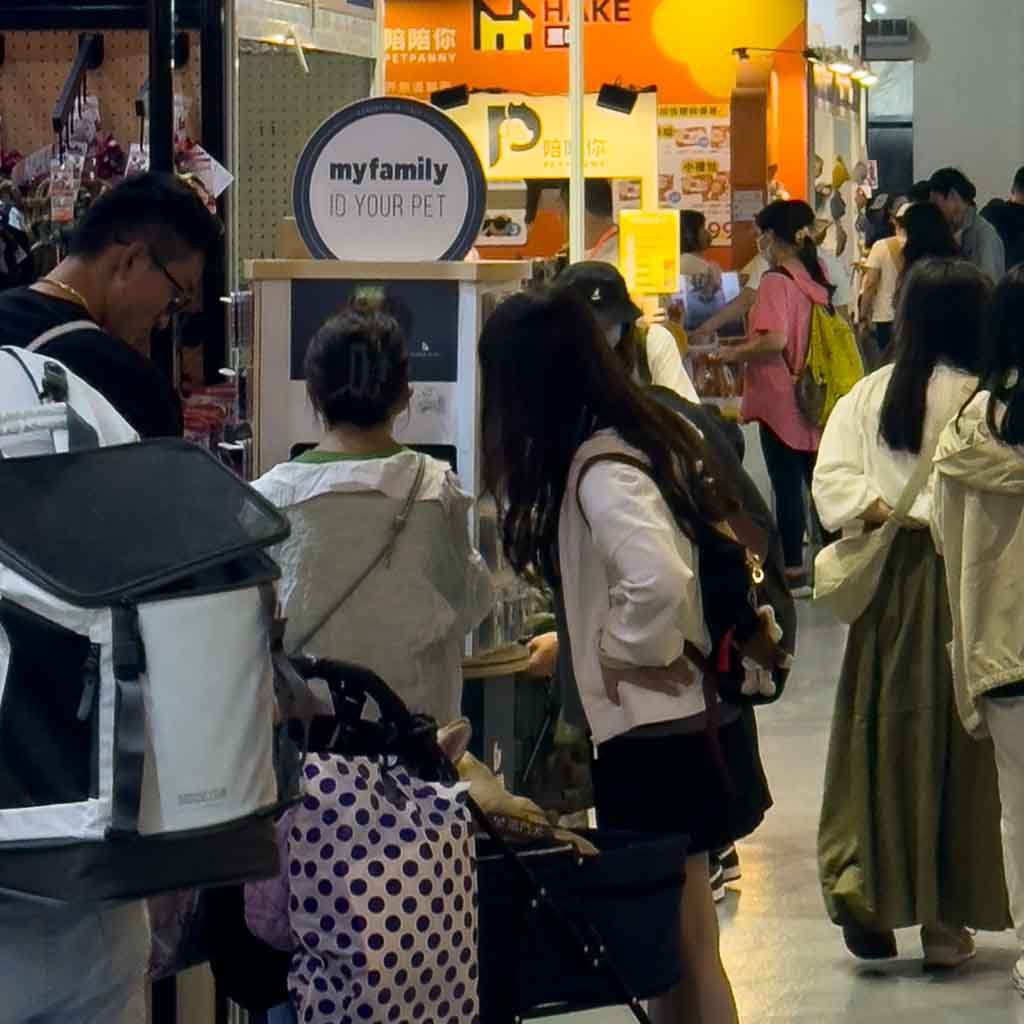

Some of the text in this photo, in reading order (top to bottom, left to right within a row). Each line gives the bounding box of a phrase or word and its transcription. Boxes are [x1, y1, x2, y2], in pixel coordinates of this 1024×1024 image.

[329, 155, 448, 185] myfamily
[329, 193, 446, 218] ID YOUR PET
